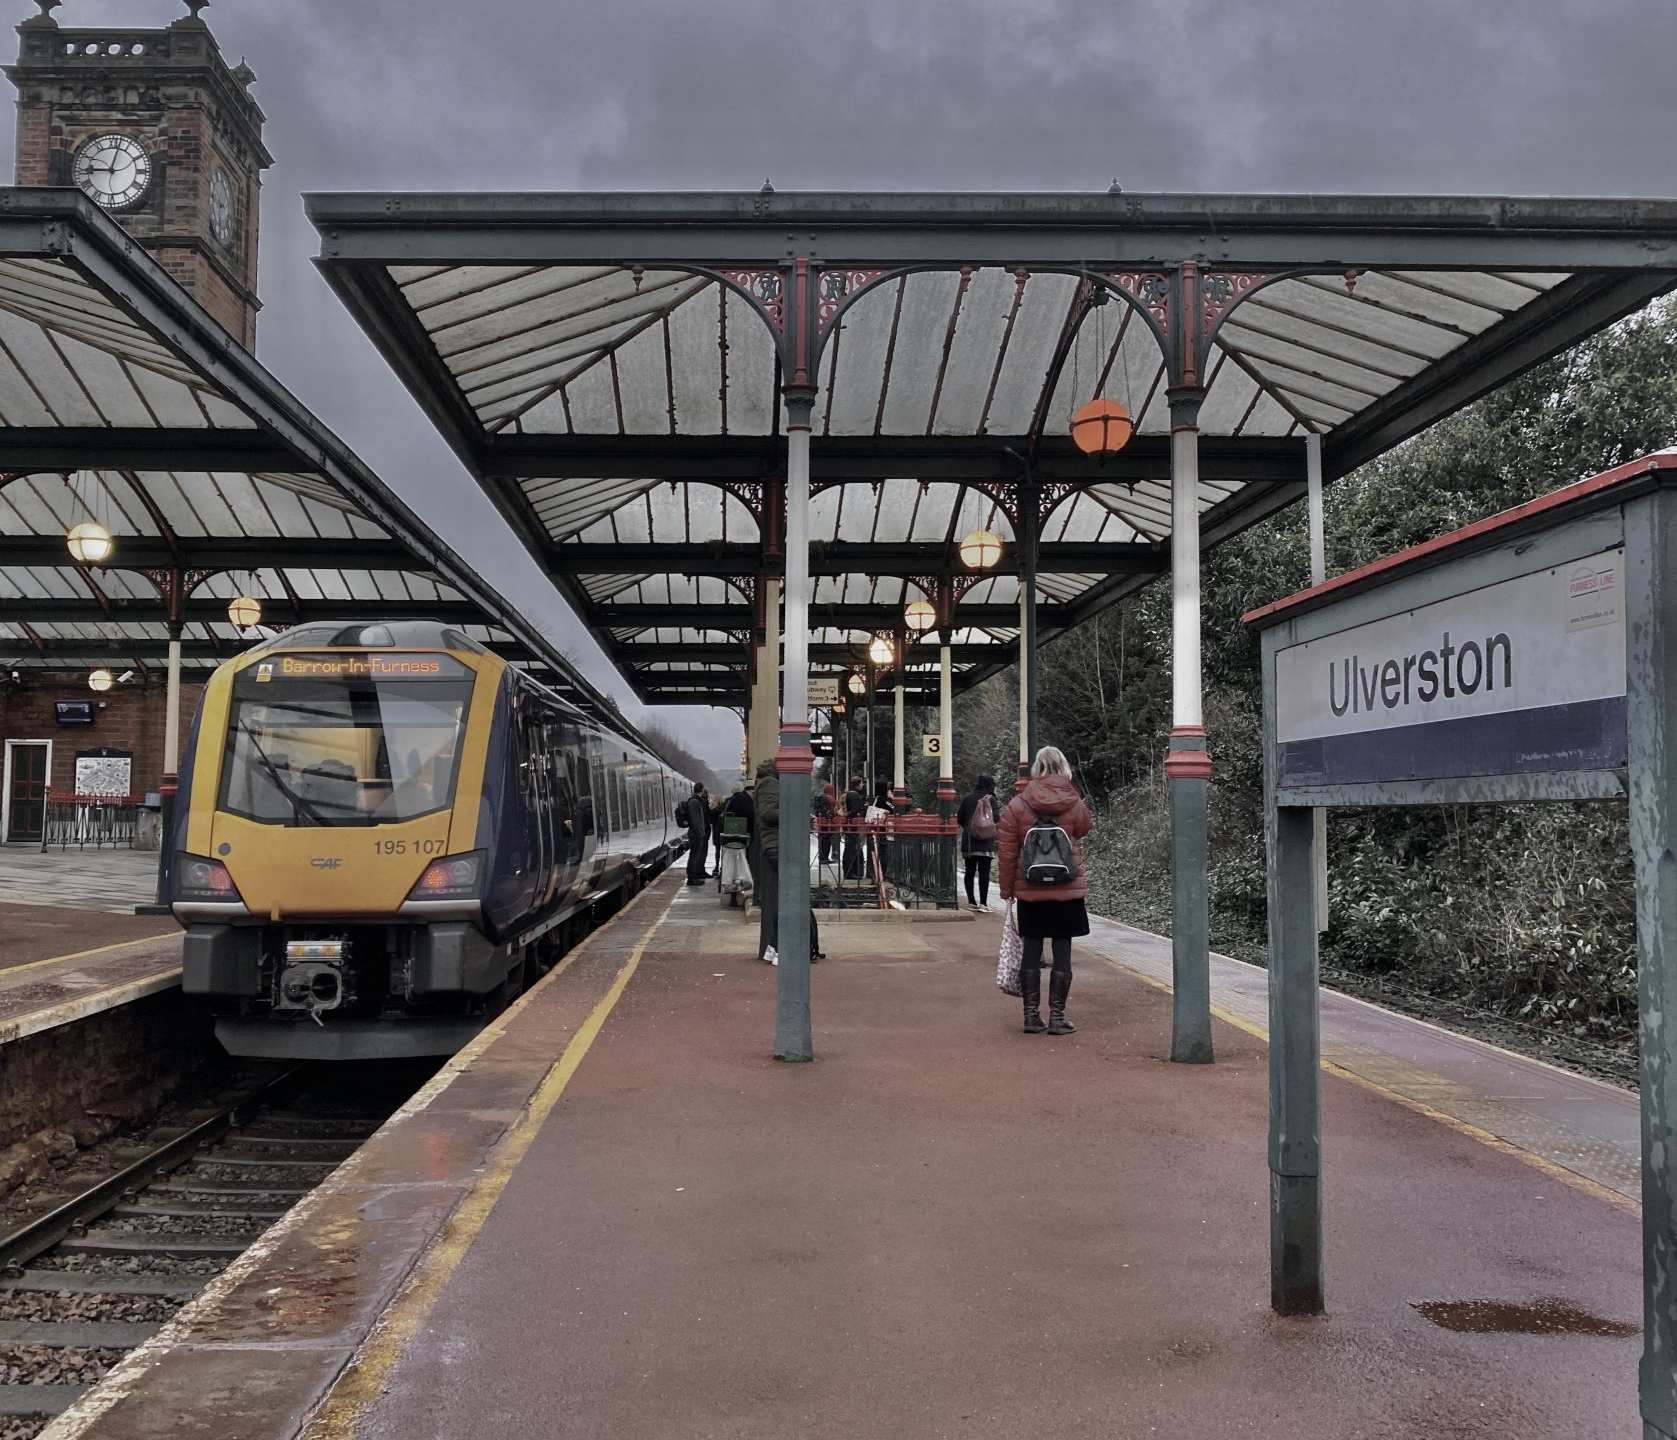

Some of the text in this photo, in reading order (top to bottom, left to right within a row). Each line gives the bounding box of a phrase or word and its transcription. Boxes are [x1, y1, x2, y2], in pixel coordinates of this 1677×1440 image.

[1570, 573, 1614, 593] FURNESS LINE
[283, 658, 440, 673] Barrow-In-Furness
[1329, 631, 1512, 717] Ulverston
[928, 738, 941, 753] 3
[374, 840, 445, 855] 195 107
[310, 858, 343, 870] CAF
